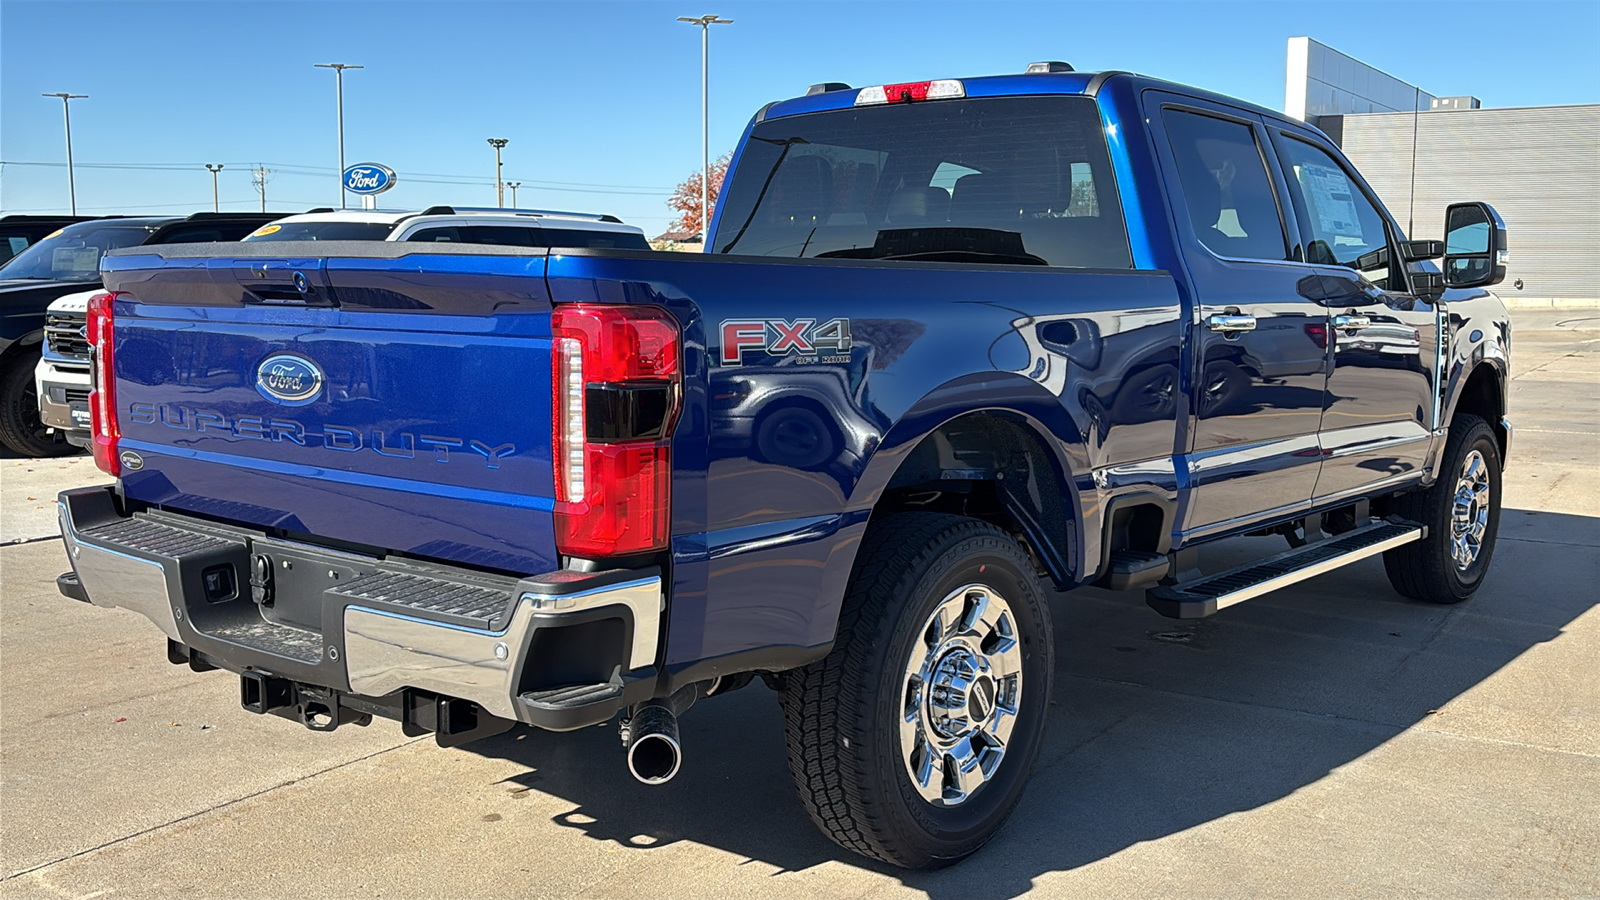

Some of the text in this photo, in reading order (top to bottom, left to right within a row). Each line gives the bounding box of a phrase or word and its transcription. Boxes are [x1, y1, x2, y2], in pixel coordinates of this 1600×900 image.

[348, 169, 380, 188] Ford
[719, 318, 852, 367] FX4
[796, 356, 818, 364] OFF
[268, 364, 304, 390] Ford
[129, 402, 516, 469] SUPER DUTY
